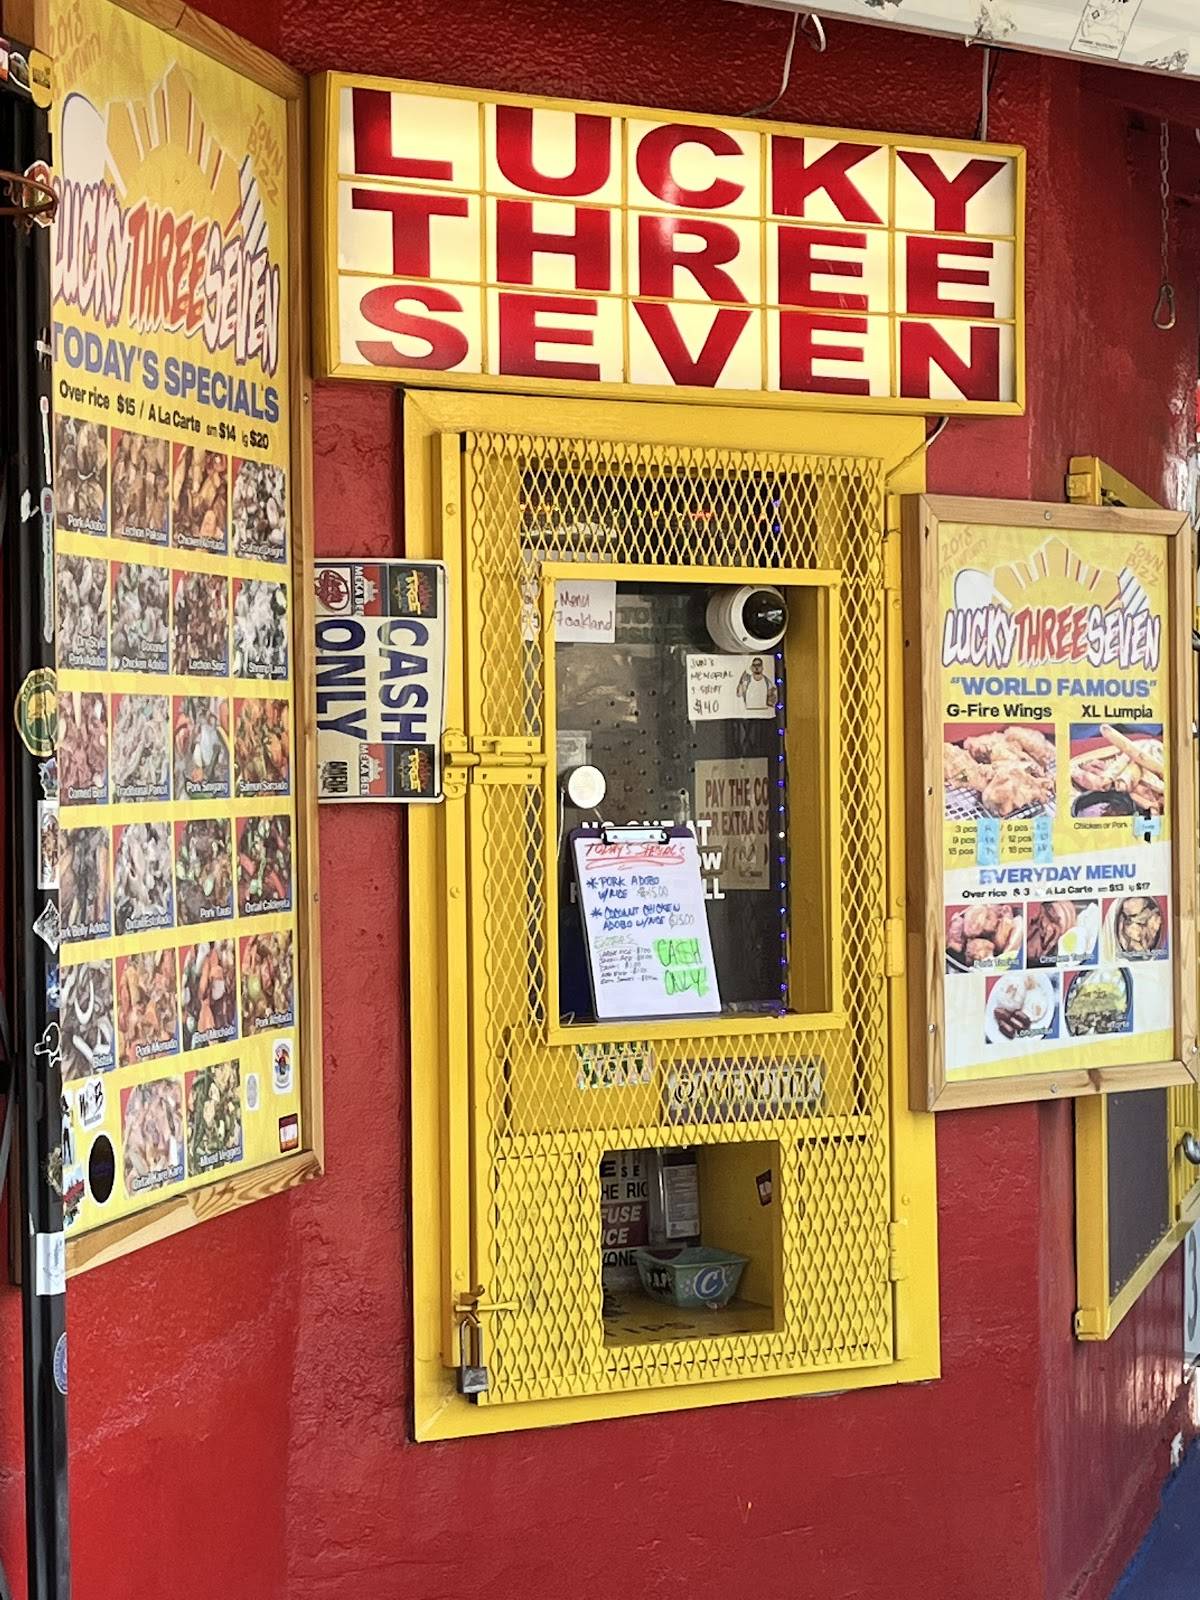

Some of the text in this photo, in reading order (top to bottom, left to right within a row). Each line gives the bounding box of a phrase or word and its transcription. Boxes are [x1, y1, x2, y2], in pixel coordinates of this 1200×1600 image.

[352, 87, 1007, 233] LUCKY
[351, 187, 996, 319] THREE
[126, 196, 211, 339] THREE
[202, 220, 280, 378] SEVEN
[53, 321, 160, 390] TODAY'S
[354, 284, 1000, 402] SEVEN
[59, 379, 87, 403] Over
[88, 386, 110, 410] rice
[116, 393, 136, 417] $15
[148, 403, 156, 422] A
[158, 407, 171, 425] La
[172, 410, 201, 434] Carte
[218, 422, 237, 442] $14
[249, 432, 270, 450] $20
[941, 602, 1161, 672] LUCKY THREE SEVEN
[315, 619, 368, 741] ONLY
[377, 619, 430, 742] CASH
[693, 699, 719, 714] $40
[946, 702, 1053, 720] G-Fire Wings
[1081, 704, 1153, 721] XL Lumpia
[705, 780, 725, 807] PAY
[729, 778, 751, 806] THE
[721, 810, 755, 835] EXTRA
[1014, 825, 1029, 833] pcs
[1073, 822, 1101, 831] Chicken
[1112, 822, 1128, 830] Pork
[958, 848, 974, 856] pcs
[1017, 846, 1032, 855] pcs
[960, 837, 976, 846] pcs
[1017, 836, 1032, 844] pcs
[979, 863, 1137, 885] EVERYDAY MENU
[961, 890, 987, 900] Over
[988, 888, 1008, 898] rice
[1054, 885, 1067, 894] La
[1067, 884, 1093, 894] Carte
[1108, 883, 1124, 893] $13
[1136, 882, 1151, 892] $17
